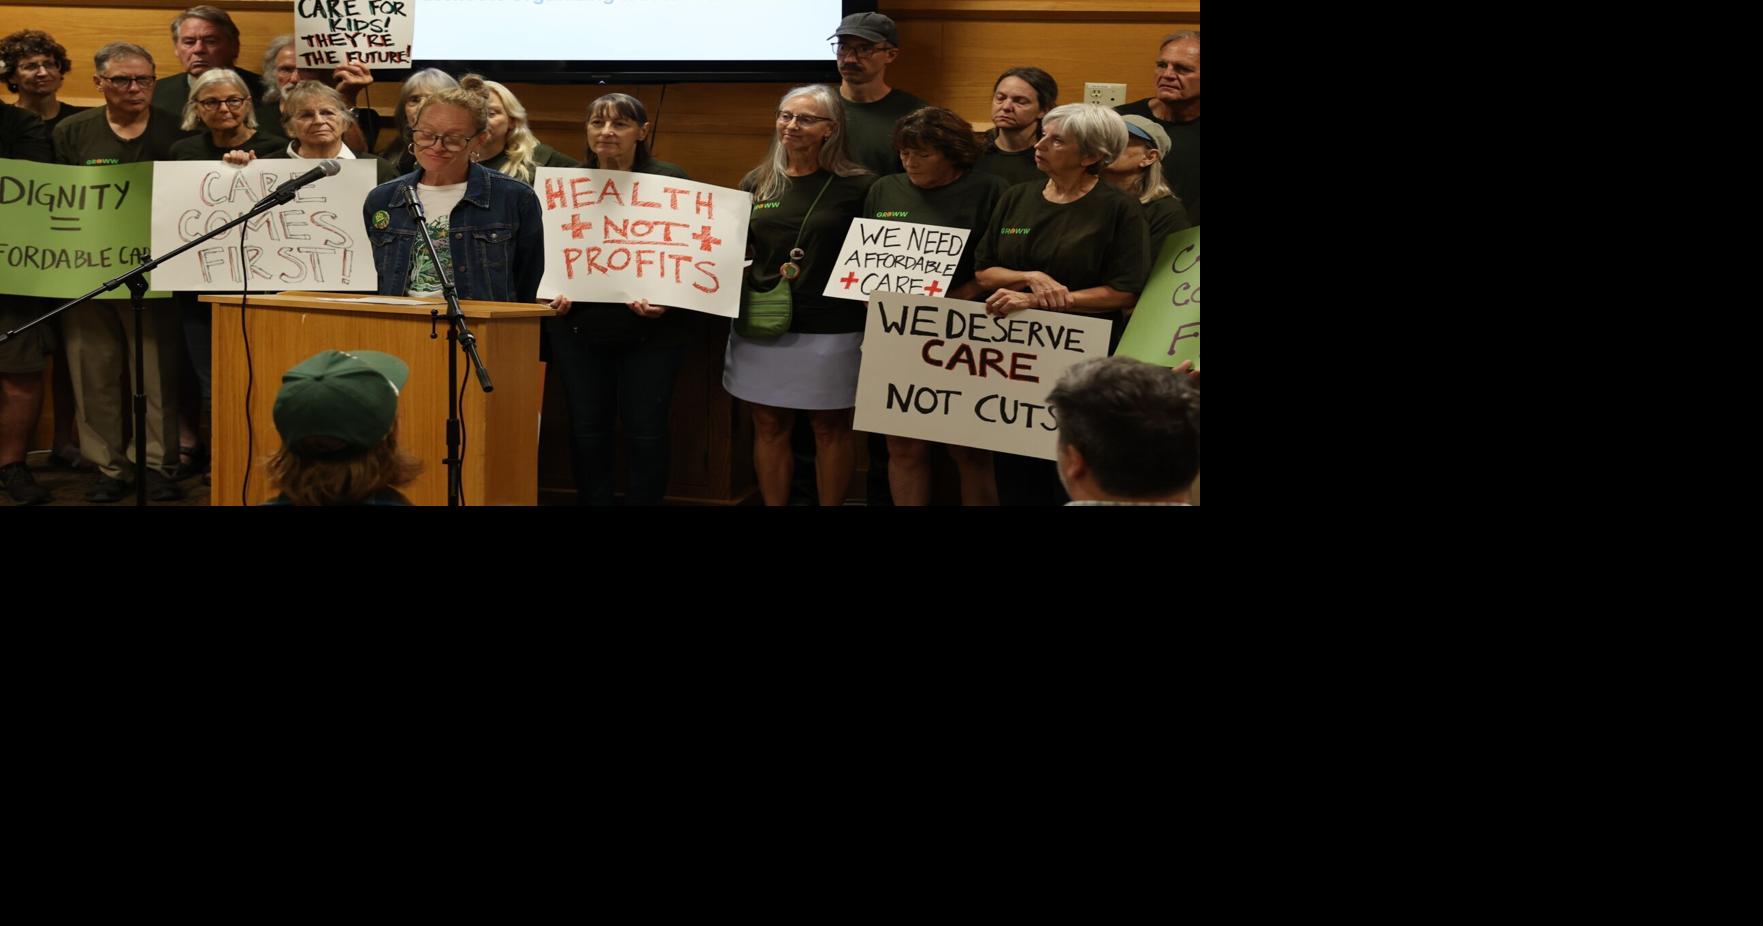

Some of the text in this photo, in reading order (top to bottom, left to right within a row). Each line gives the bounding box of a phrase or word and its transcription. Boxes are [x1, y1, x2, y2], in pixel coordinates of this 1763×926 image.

[298, 0, 407, 19] CARE FOR
[329, 16, 391, 33] KIDS!
[299, 45, 412, 66] THE FUTURE!
[301, 33, 395, 48] THEY'RE
[0, 176, 130, 212] DIGNITY
[201, 170, 327, 207] CARE
[544, 176, 714, 220] HEALTH
[178, 209, 353, 249] COMES
[603, 215, 690, 242] NOT
[860, 223, 963, 257] WE NEED
[198, 245, 353, 286] FIRST!
[563, 246, 720, 294] PROFITS
[844, 250, 957, 277] AFFORDABLE
[860, 272, 925, 296] CARE
[878, 301, 1085, 353] WE DESERVE
[921, 338, 1040, 384] CARE
[886, 383, 1058, 432] NOT CUTS
